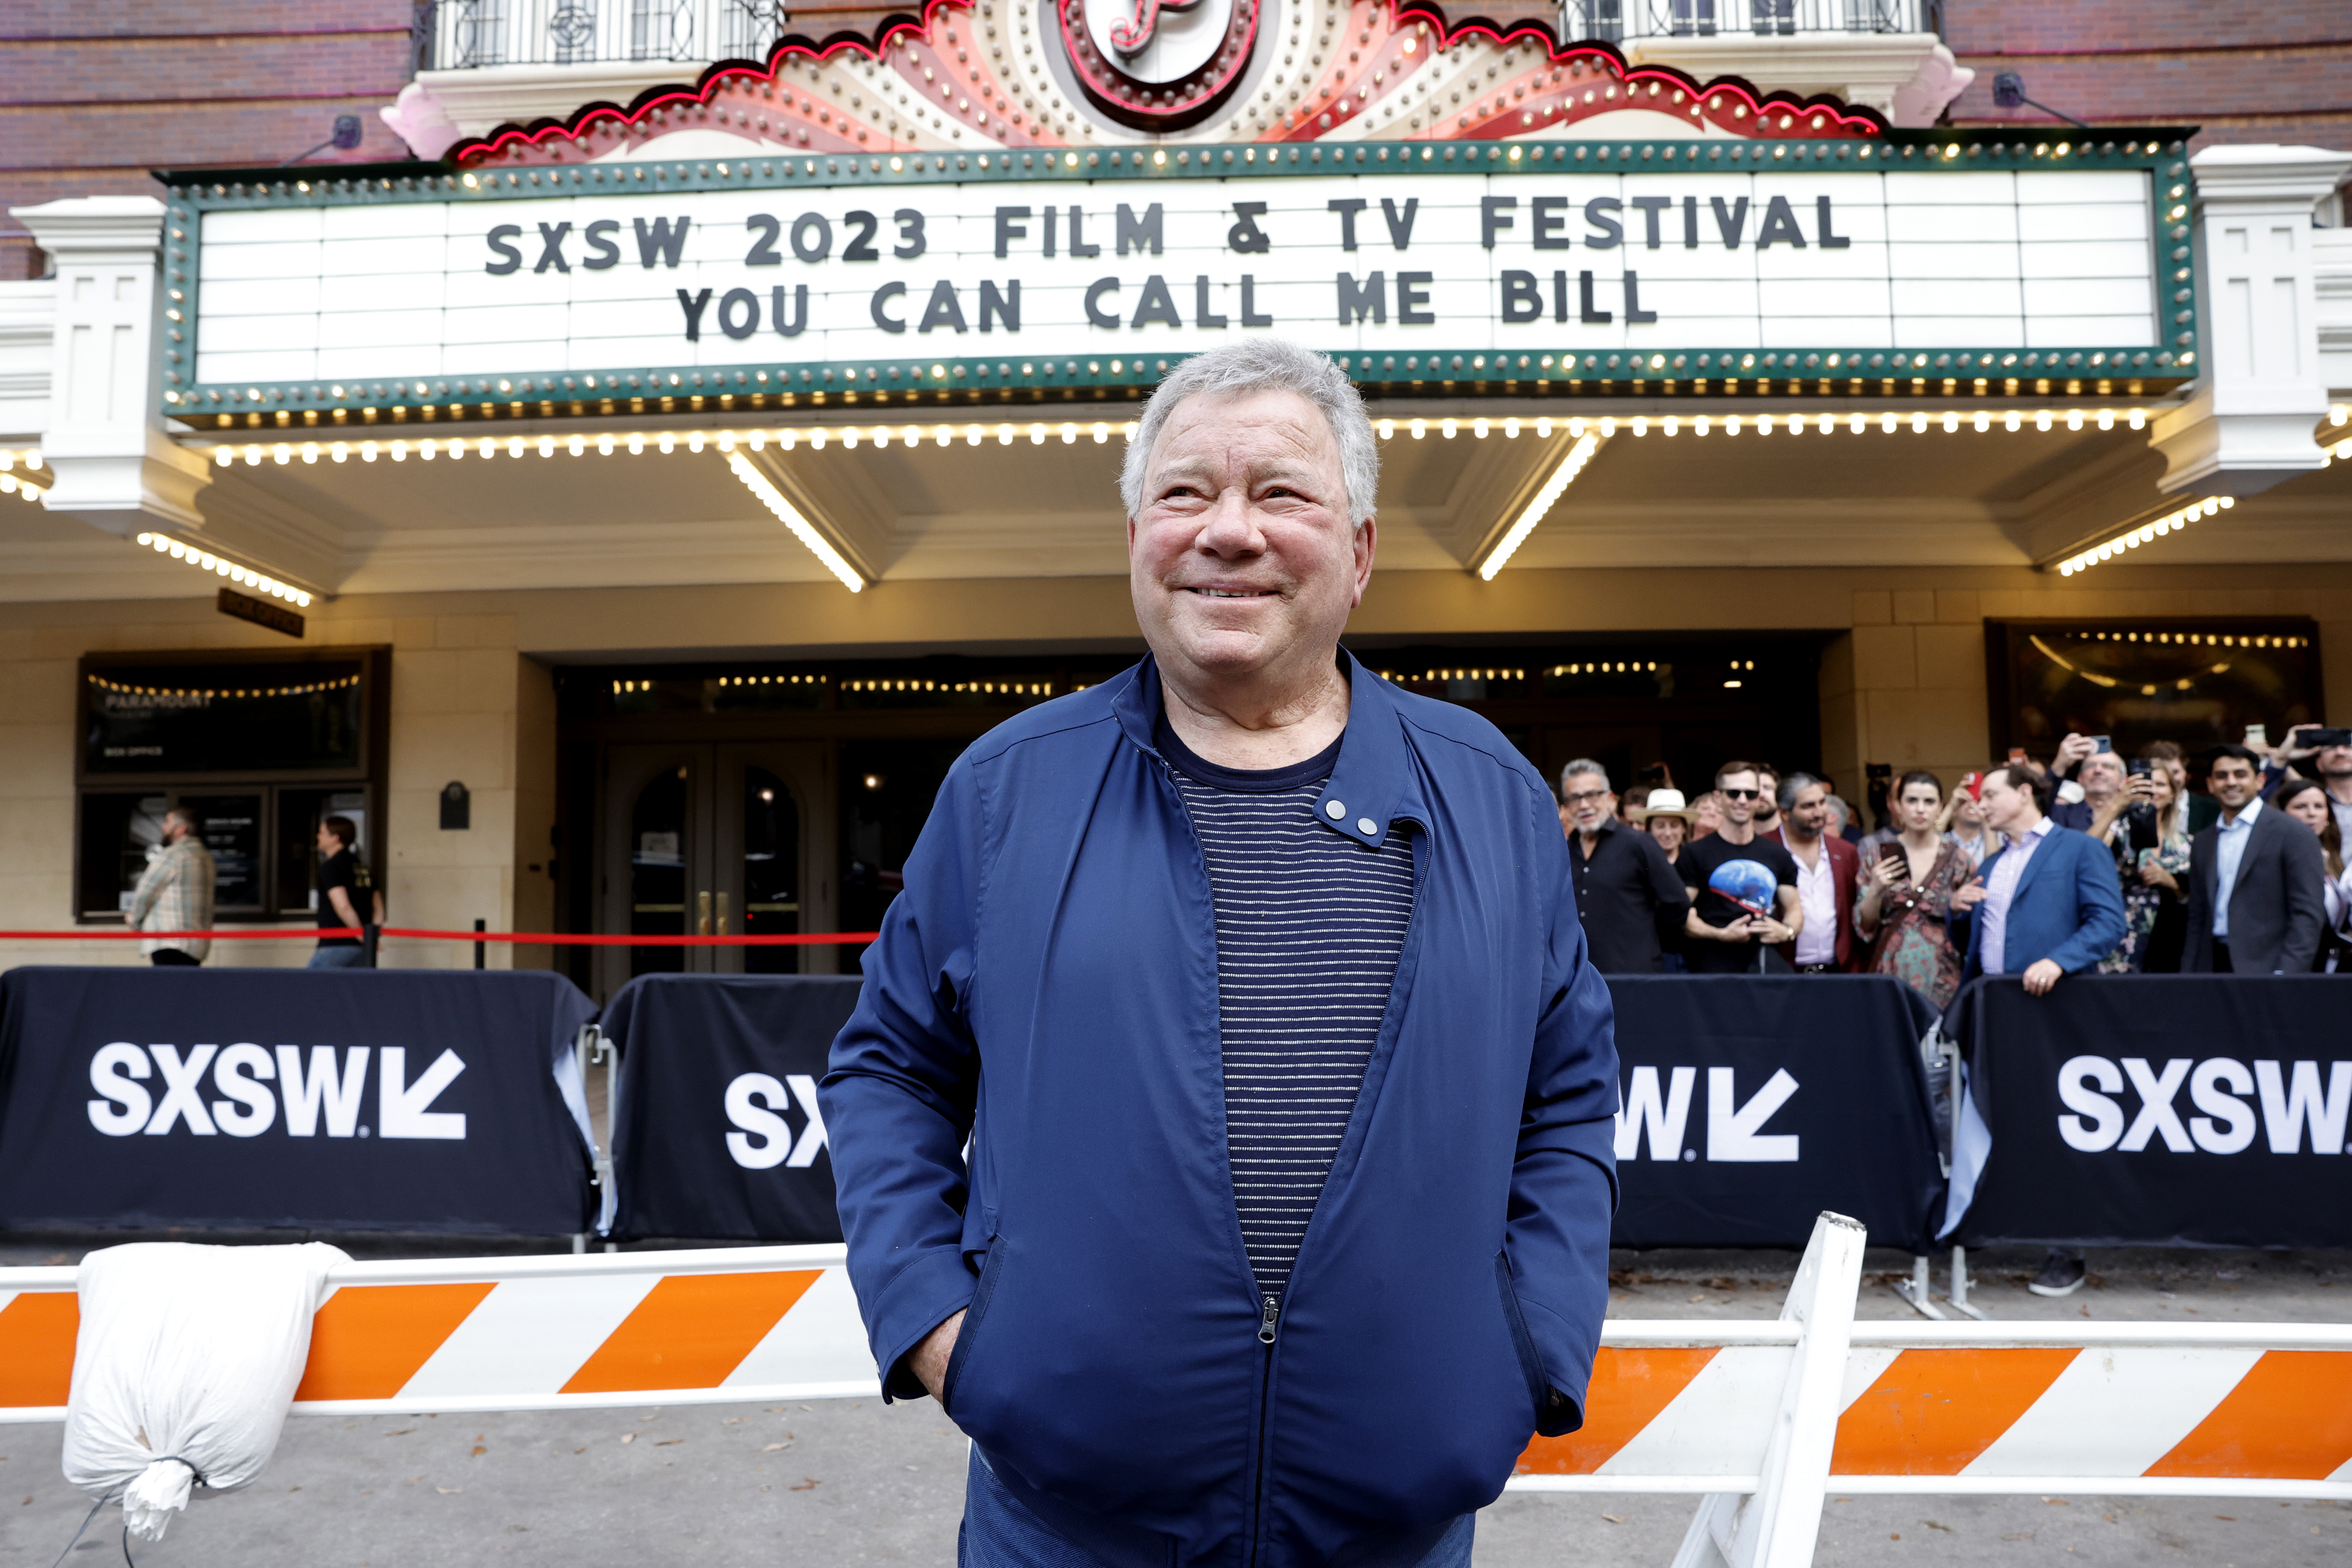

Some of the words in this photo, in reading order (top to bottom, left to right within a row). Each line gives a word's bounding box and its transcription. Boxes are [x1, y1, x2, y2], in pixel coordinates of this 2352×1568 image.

[486, 217, 689, 274] SXSW
[746, 209, 925, 265] 2023
[995, 203, 1163, 257] FILM
[1229, 201, 1270, 253] &
[1328, 198, 1418, 250] TV
[1481, 196, 1850, 250] FESTIVAL
[677, 285, 808, 341] YOU
[871, 280, 1020, 333] CAN
[1085, 276, 1272, 328] CALL
[1337, 272, 1434, 324] ME
[1501, 270, 1657, 323] BILL
[88, 1043, 370, 1137] SXSW
[725, 1073, 829, 1169] SX
[2058, 1055, 2352, 1154] SXSW
